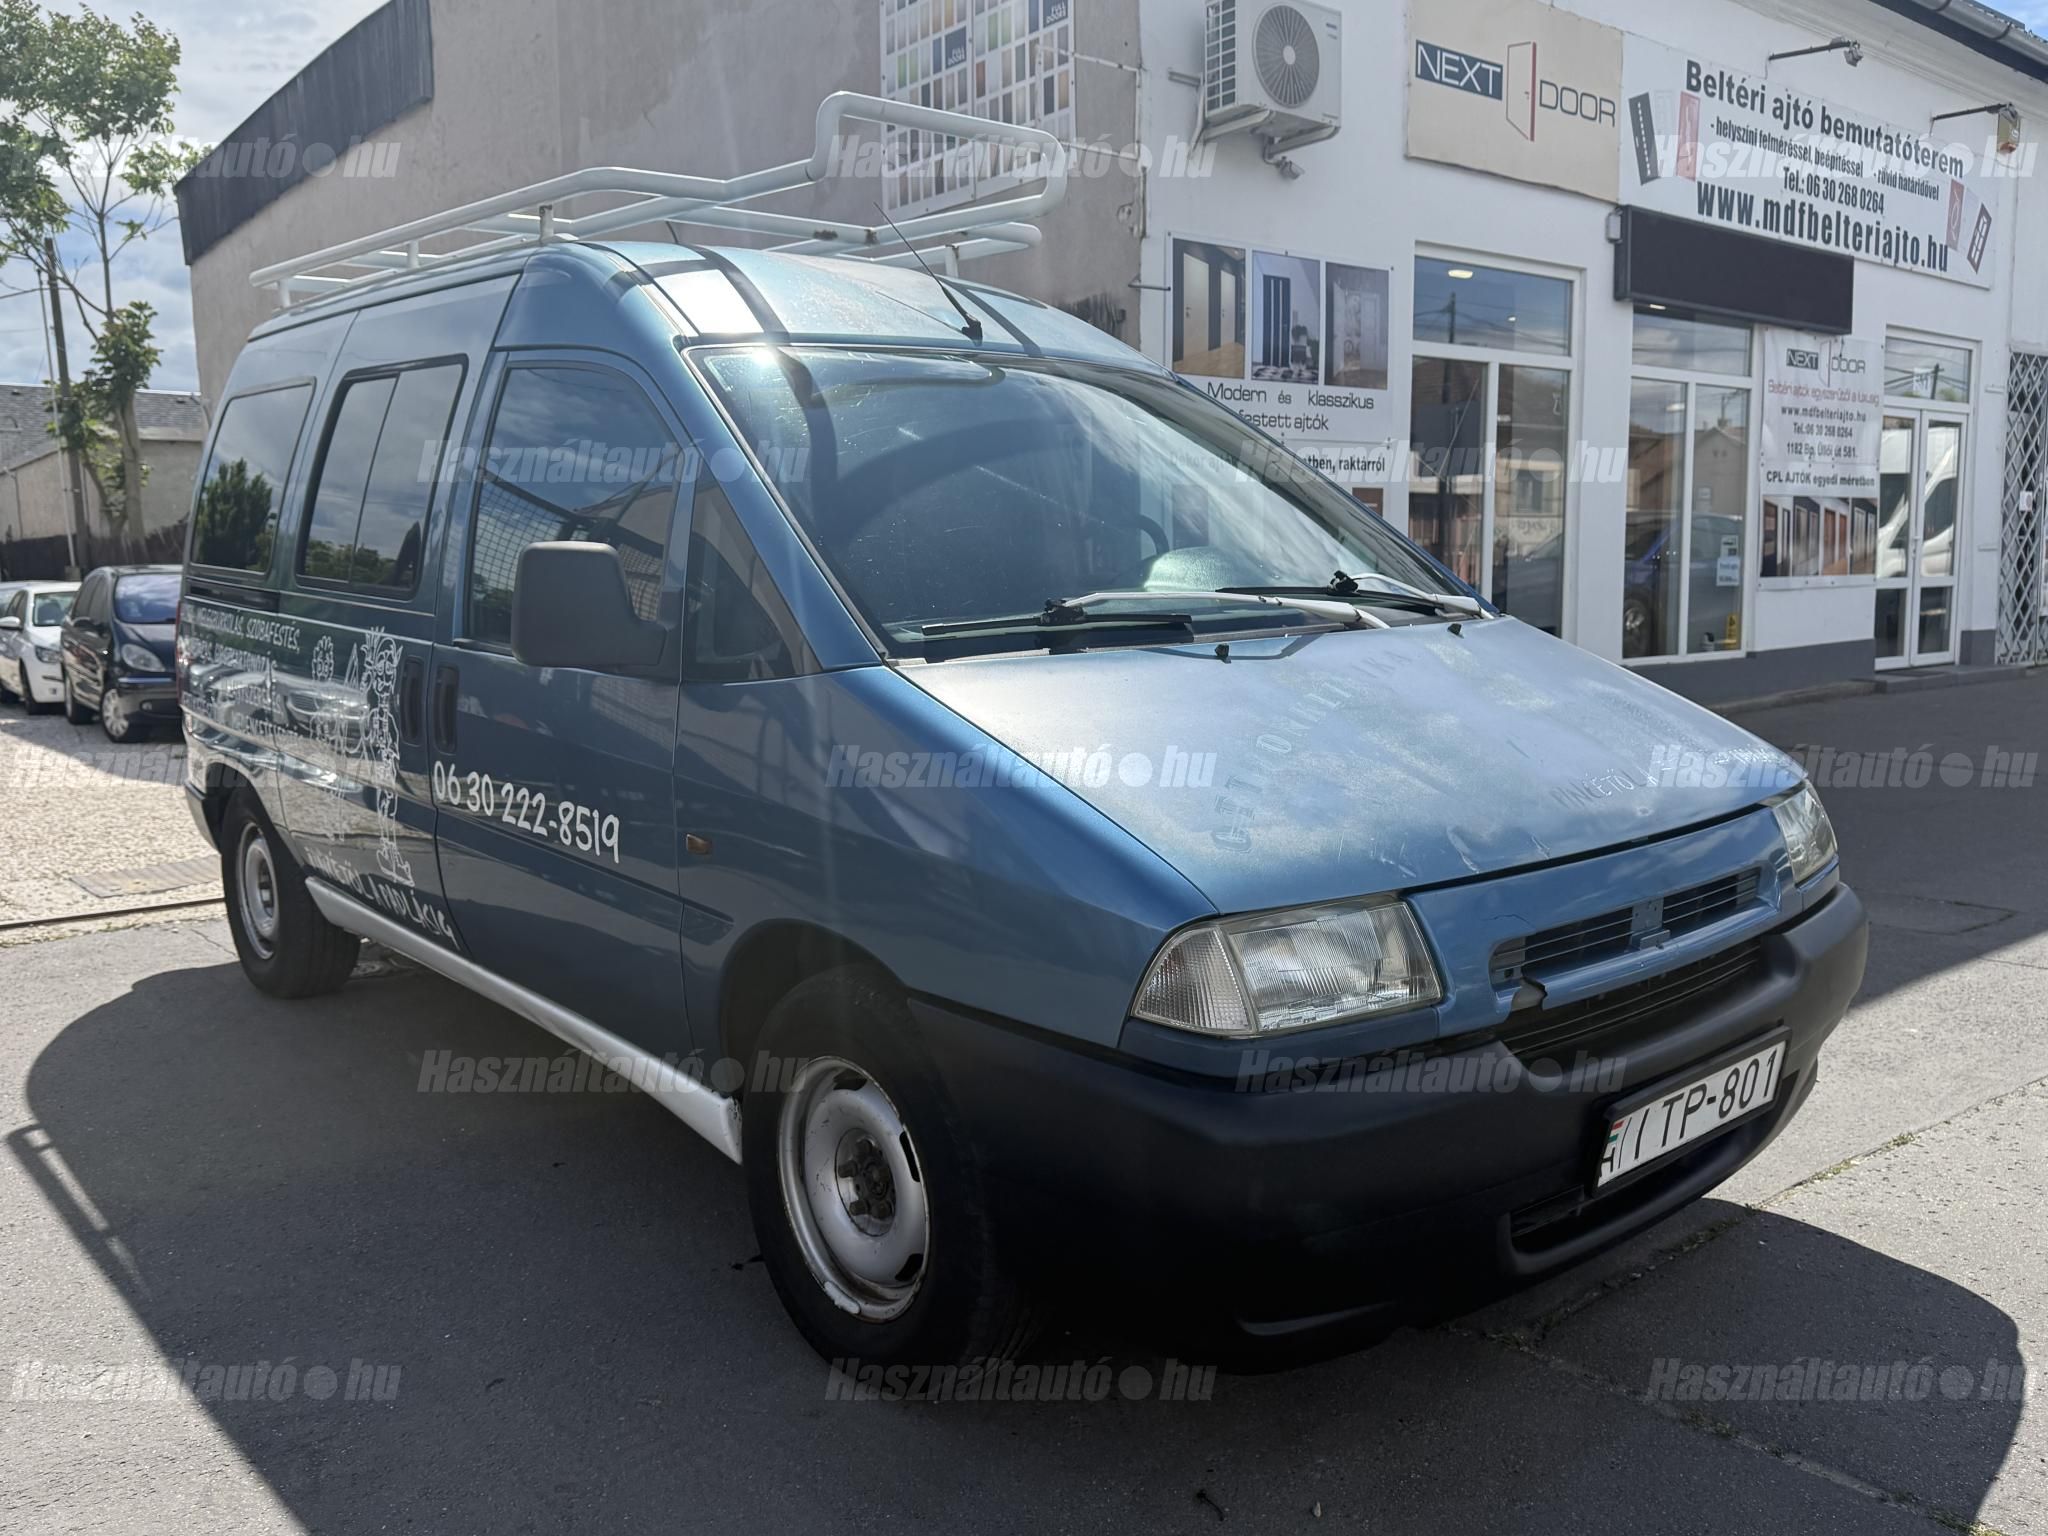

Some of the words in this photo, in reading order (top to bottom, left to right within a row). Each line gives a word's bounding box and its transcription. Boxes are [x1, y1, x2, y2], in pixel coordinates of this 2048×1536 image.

[1416, 44, 1501, 95] NEXT
[1539, 79, 1616, 127] DOOR
[1686, 60, 1765, 114] Beltéri
[1772, 90, 1813, 130] ajtó
[1820, 105, 1964, 178] bemutatóterem
[1716, 116, 1757, 147] helyszíni
[1758, 129, 1813, 166] felméréssel,
[1814, 144, 1863, 178] beépítéssel
[1783, 167, 1805, 194] Tel.:
[1806, 173, 1820, 196] 06
[1822, 178, 1836, 203] 30
[1838, 182, 1857, 209] 268
[1859, 188, 1884, 215] 0264
[1697, 181, 1949, 273] www.mdfbelteriajto.hu
[1788, 350, 1818, 368] NEXT
[1831, 356, 1866, 374] DOOR
[1207, 382, 1267, 401] Modern
[1278, 390, 1292, 404] és
[1308, 390, 1374, 409] klasszikus
[1294, 411, 1329, 433] ajtók
[1339, 456, 1385, 473] raktárról
[1766, 471, 1783, 483] CPL
[434, 761, 461, 805] 06
[467, 768, 494, 816] 30
[501, 782, 620, 864] 222-8519
